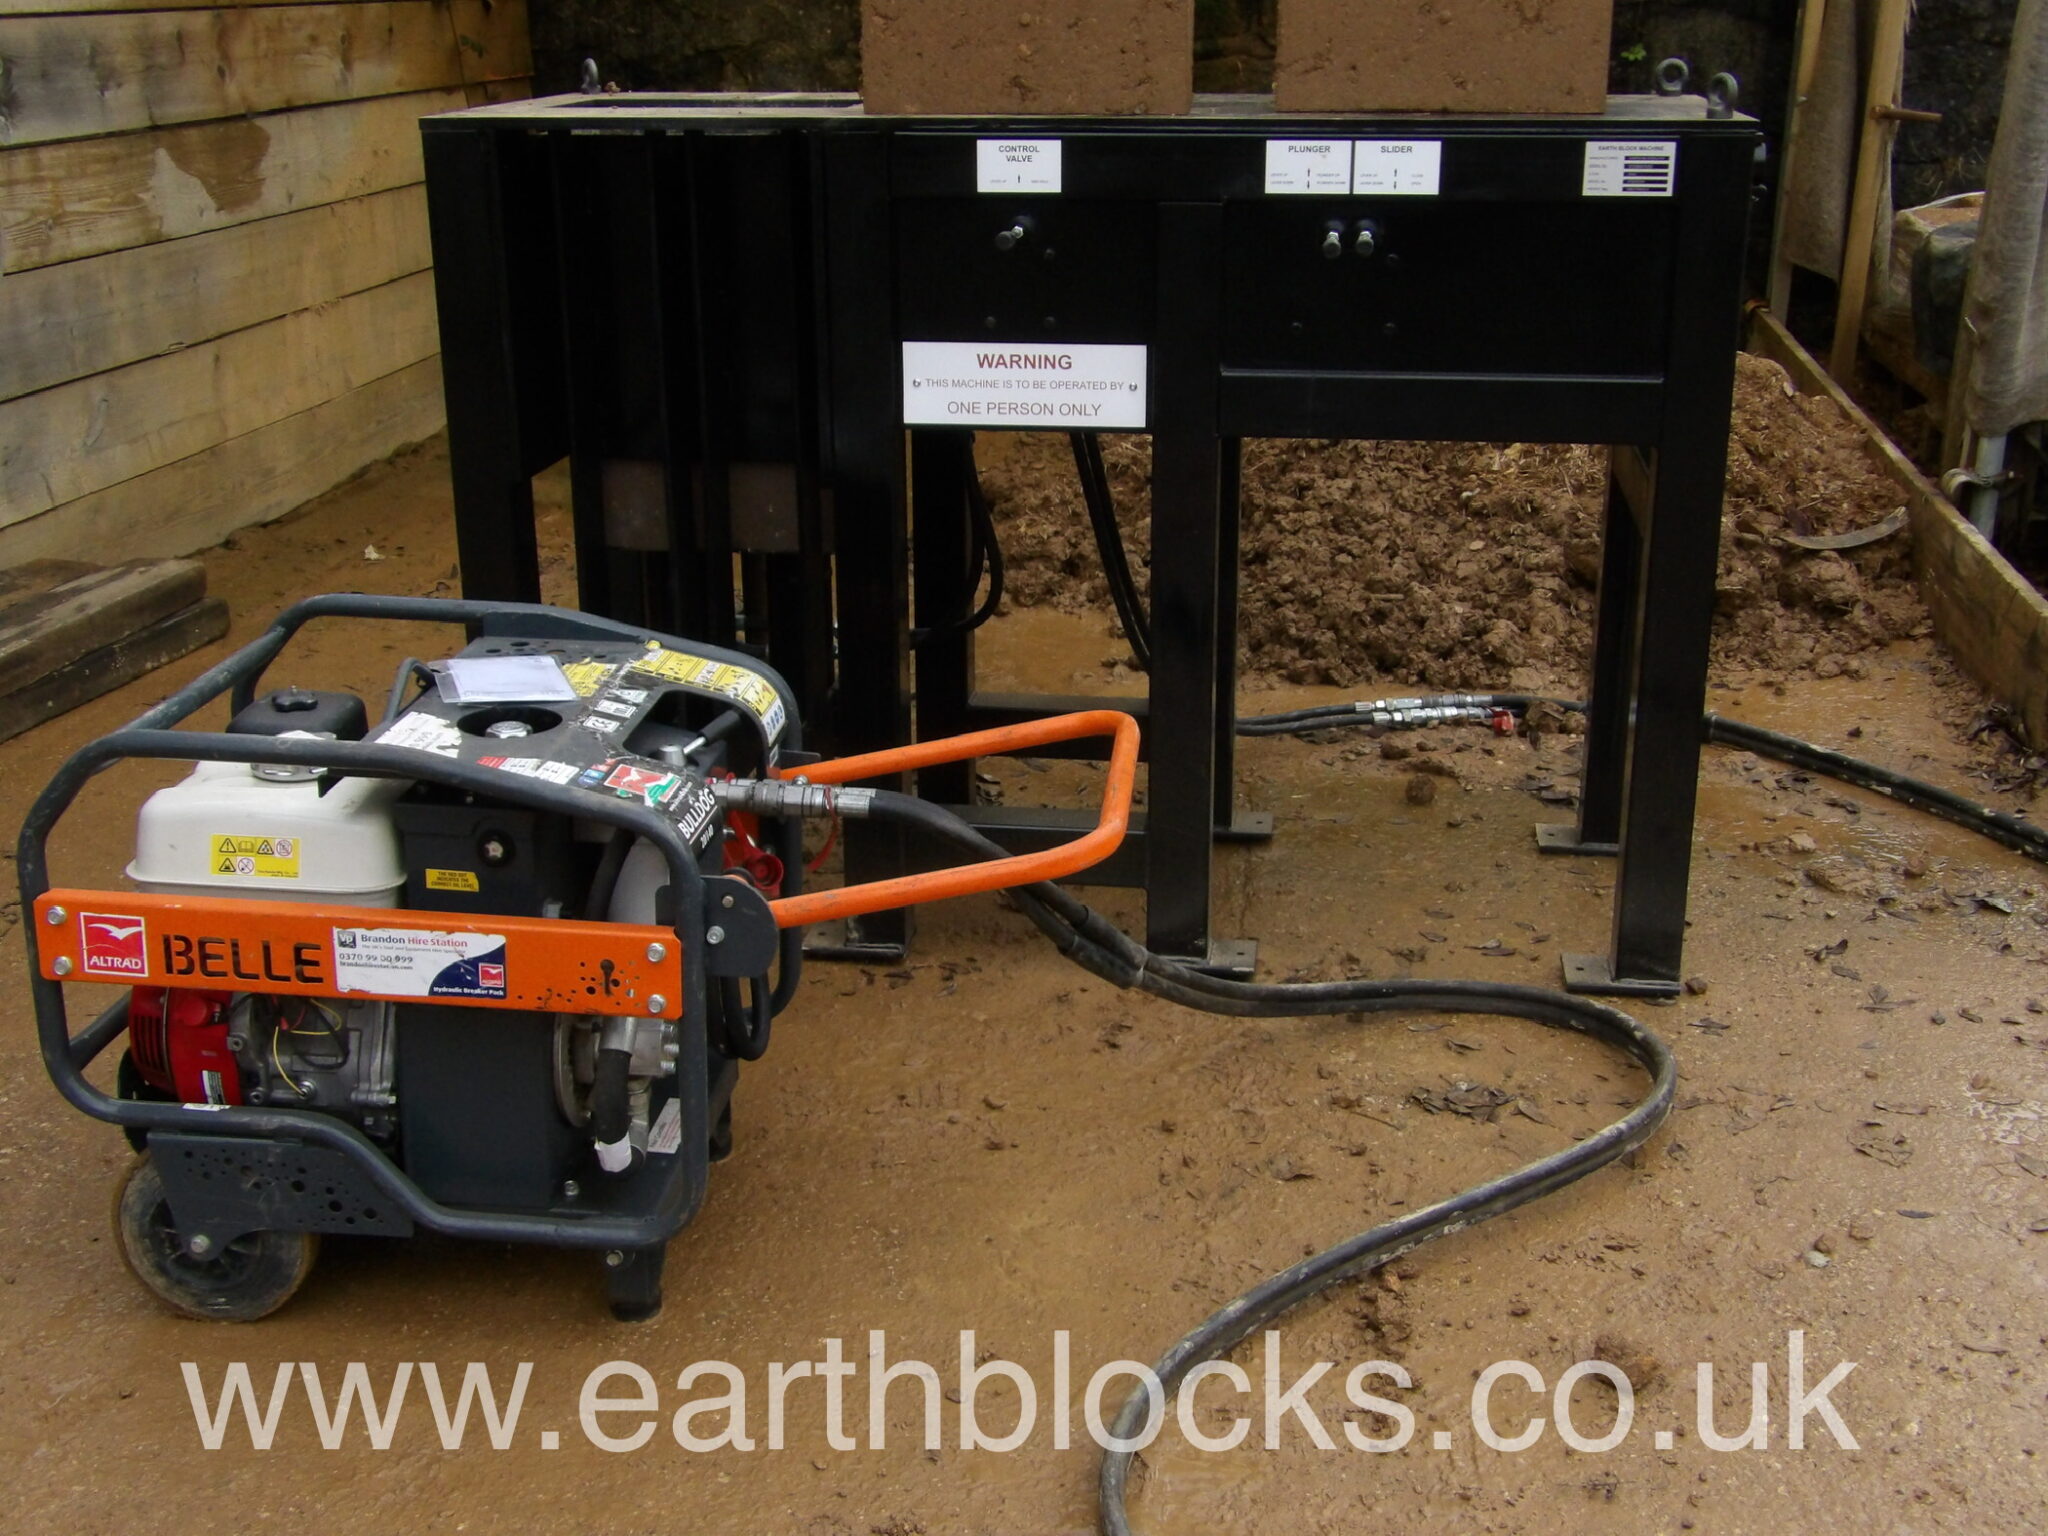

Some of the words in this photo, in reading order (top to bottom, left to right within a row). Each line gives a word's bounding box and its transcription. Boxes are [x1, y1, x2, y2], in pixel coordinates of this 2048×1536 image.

[998, 145, 1040, 153] CONTROL
[1288, 145, 1331, 153] PLUNGER
[1380, 145, 1413, 153] SLIDER
[976, 353, 1073, 370] WARNING
[926, 378, 949, 388] THIS
[951, 378, 1000, 389] MACHINE
[1002, 379, 1013, 389] IS
[1015, 379, 1030, 389] TO
[1033, 380, 1047, 390] BE
[1049, 380, 1108, 390] OPERATED
[1110, 381, 1124, 390] BY
[947, 401, 981, 415] ONE
[986, 402, 1054, 416] PERSON
[1059, 403, 1102, 417] ONLY
[677, 787, 716, 840] BULLDOG
[361, 934, 406, 944] Brandon
[408, 937, 429, 946] Hire
[430, 938, 468, 948] Station
[90, 954, 142, 970] ALTRAD
[161, 934, 324, 984] BELLE
[339, 953, 363, 961] 0370
